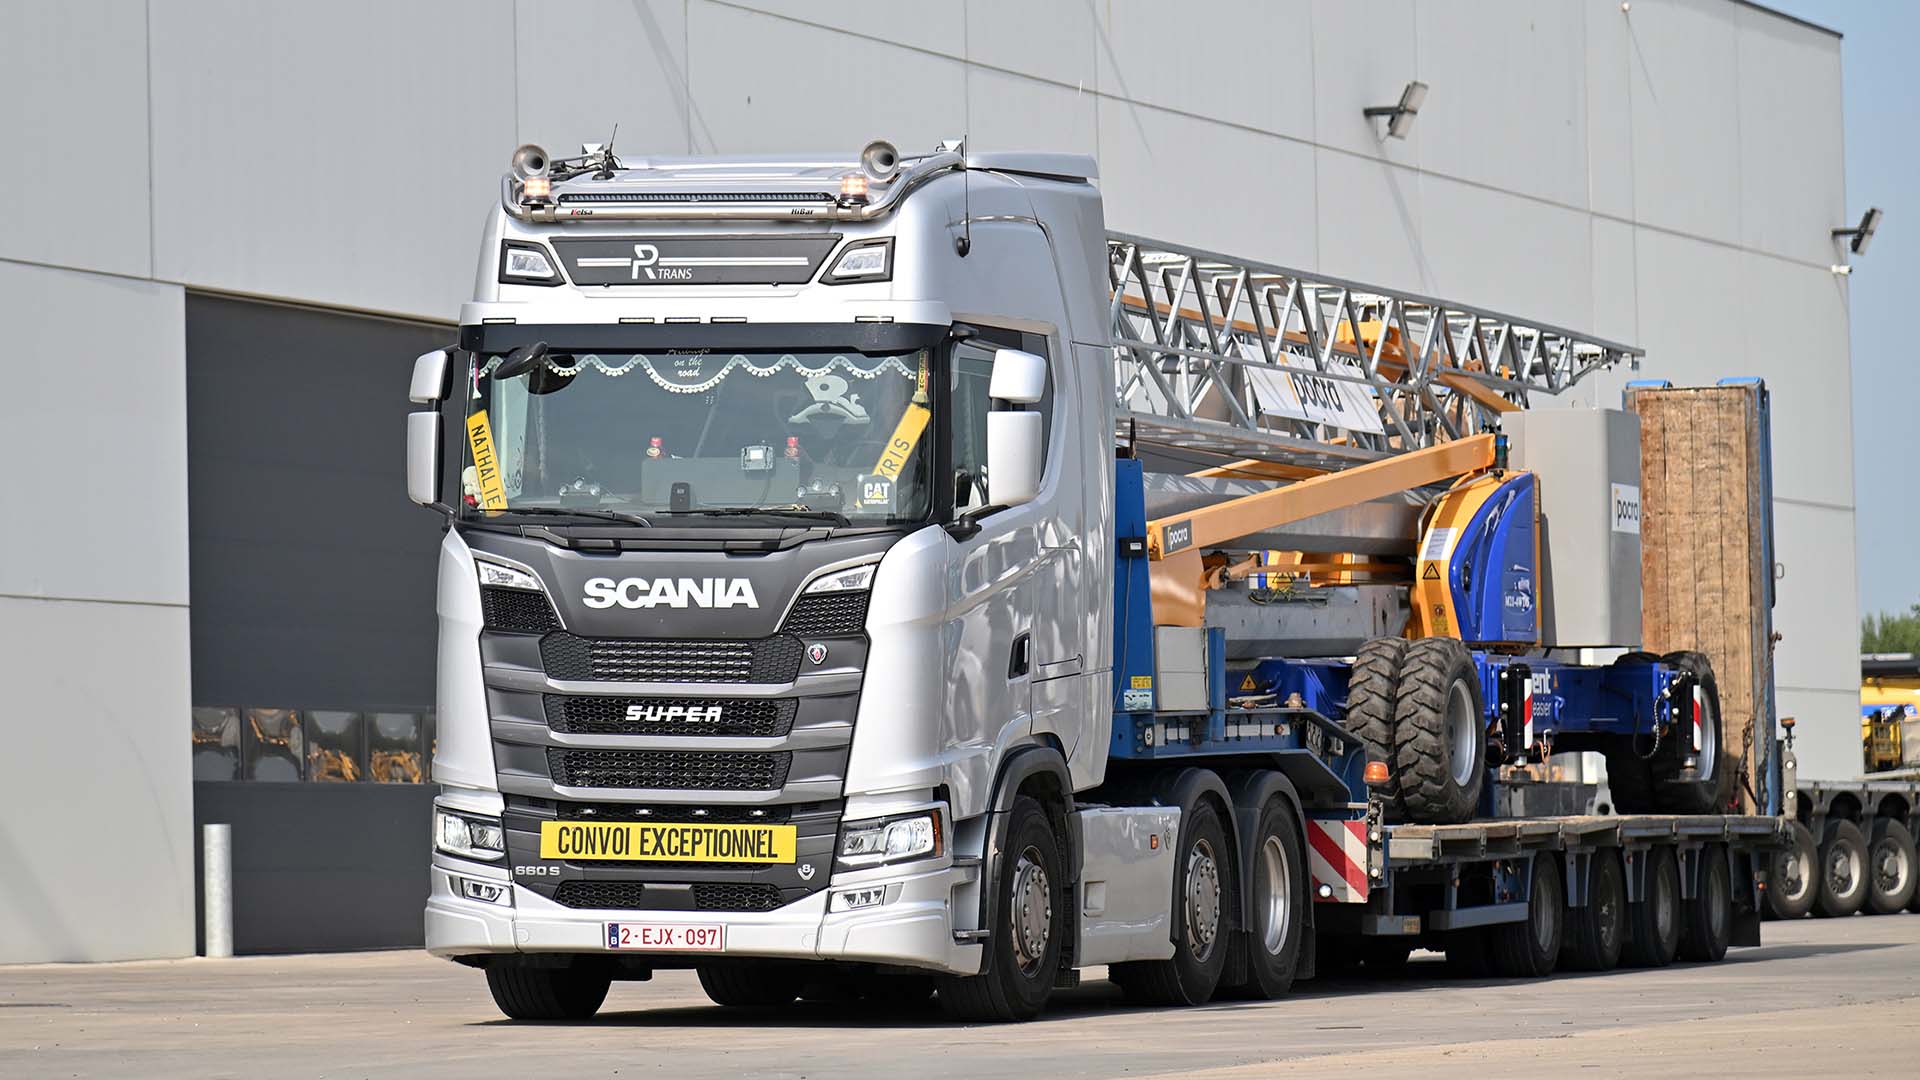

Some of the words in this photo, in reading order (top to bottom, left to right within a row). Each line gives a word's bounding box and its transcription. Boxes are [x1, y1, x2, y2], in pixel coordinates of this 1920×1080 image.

[658, 268, 692, 279] TRANS
[688, 354, 703, 367] the
[677, 367, 700, 377] road
[1290, 371, 1345, 418] pocra
[472, 424, 501, 508] NATHALIE
[863, 482, 890, 499] CAT
[1616, 499, 1638, 527] pocra
[582, 577, 760, 609] SCANIA
[625, 705, 723, 722] SUPER
[557, 826, 631, 855] CONVOI
[639, 828, 778, 858] EXCEPTIONNEL
[515, 866, 547, 876] 660
[549, 866, 560, 876] S
[610, 936, 618, 945] B
[621, 928, 717, 945] 2-EJX-097
